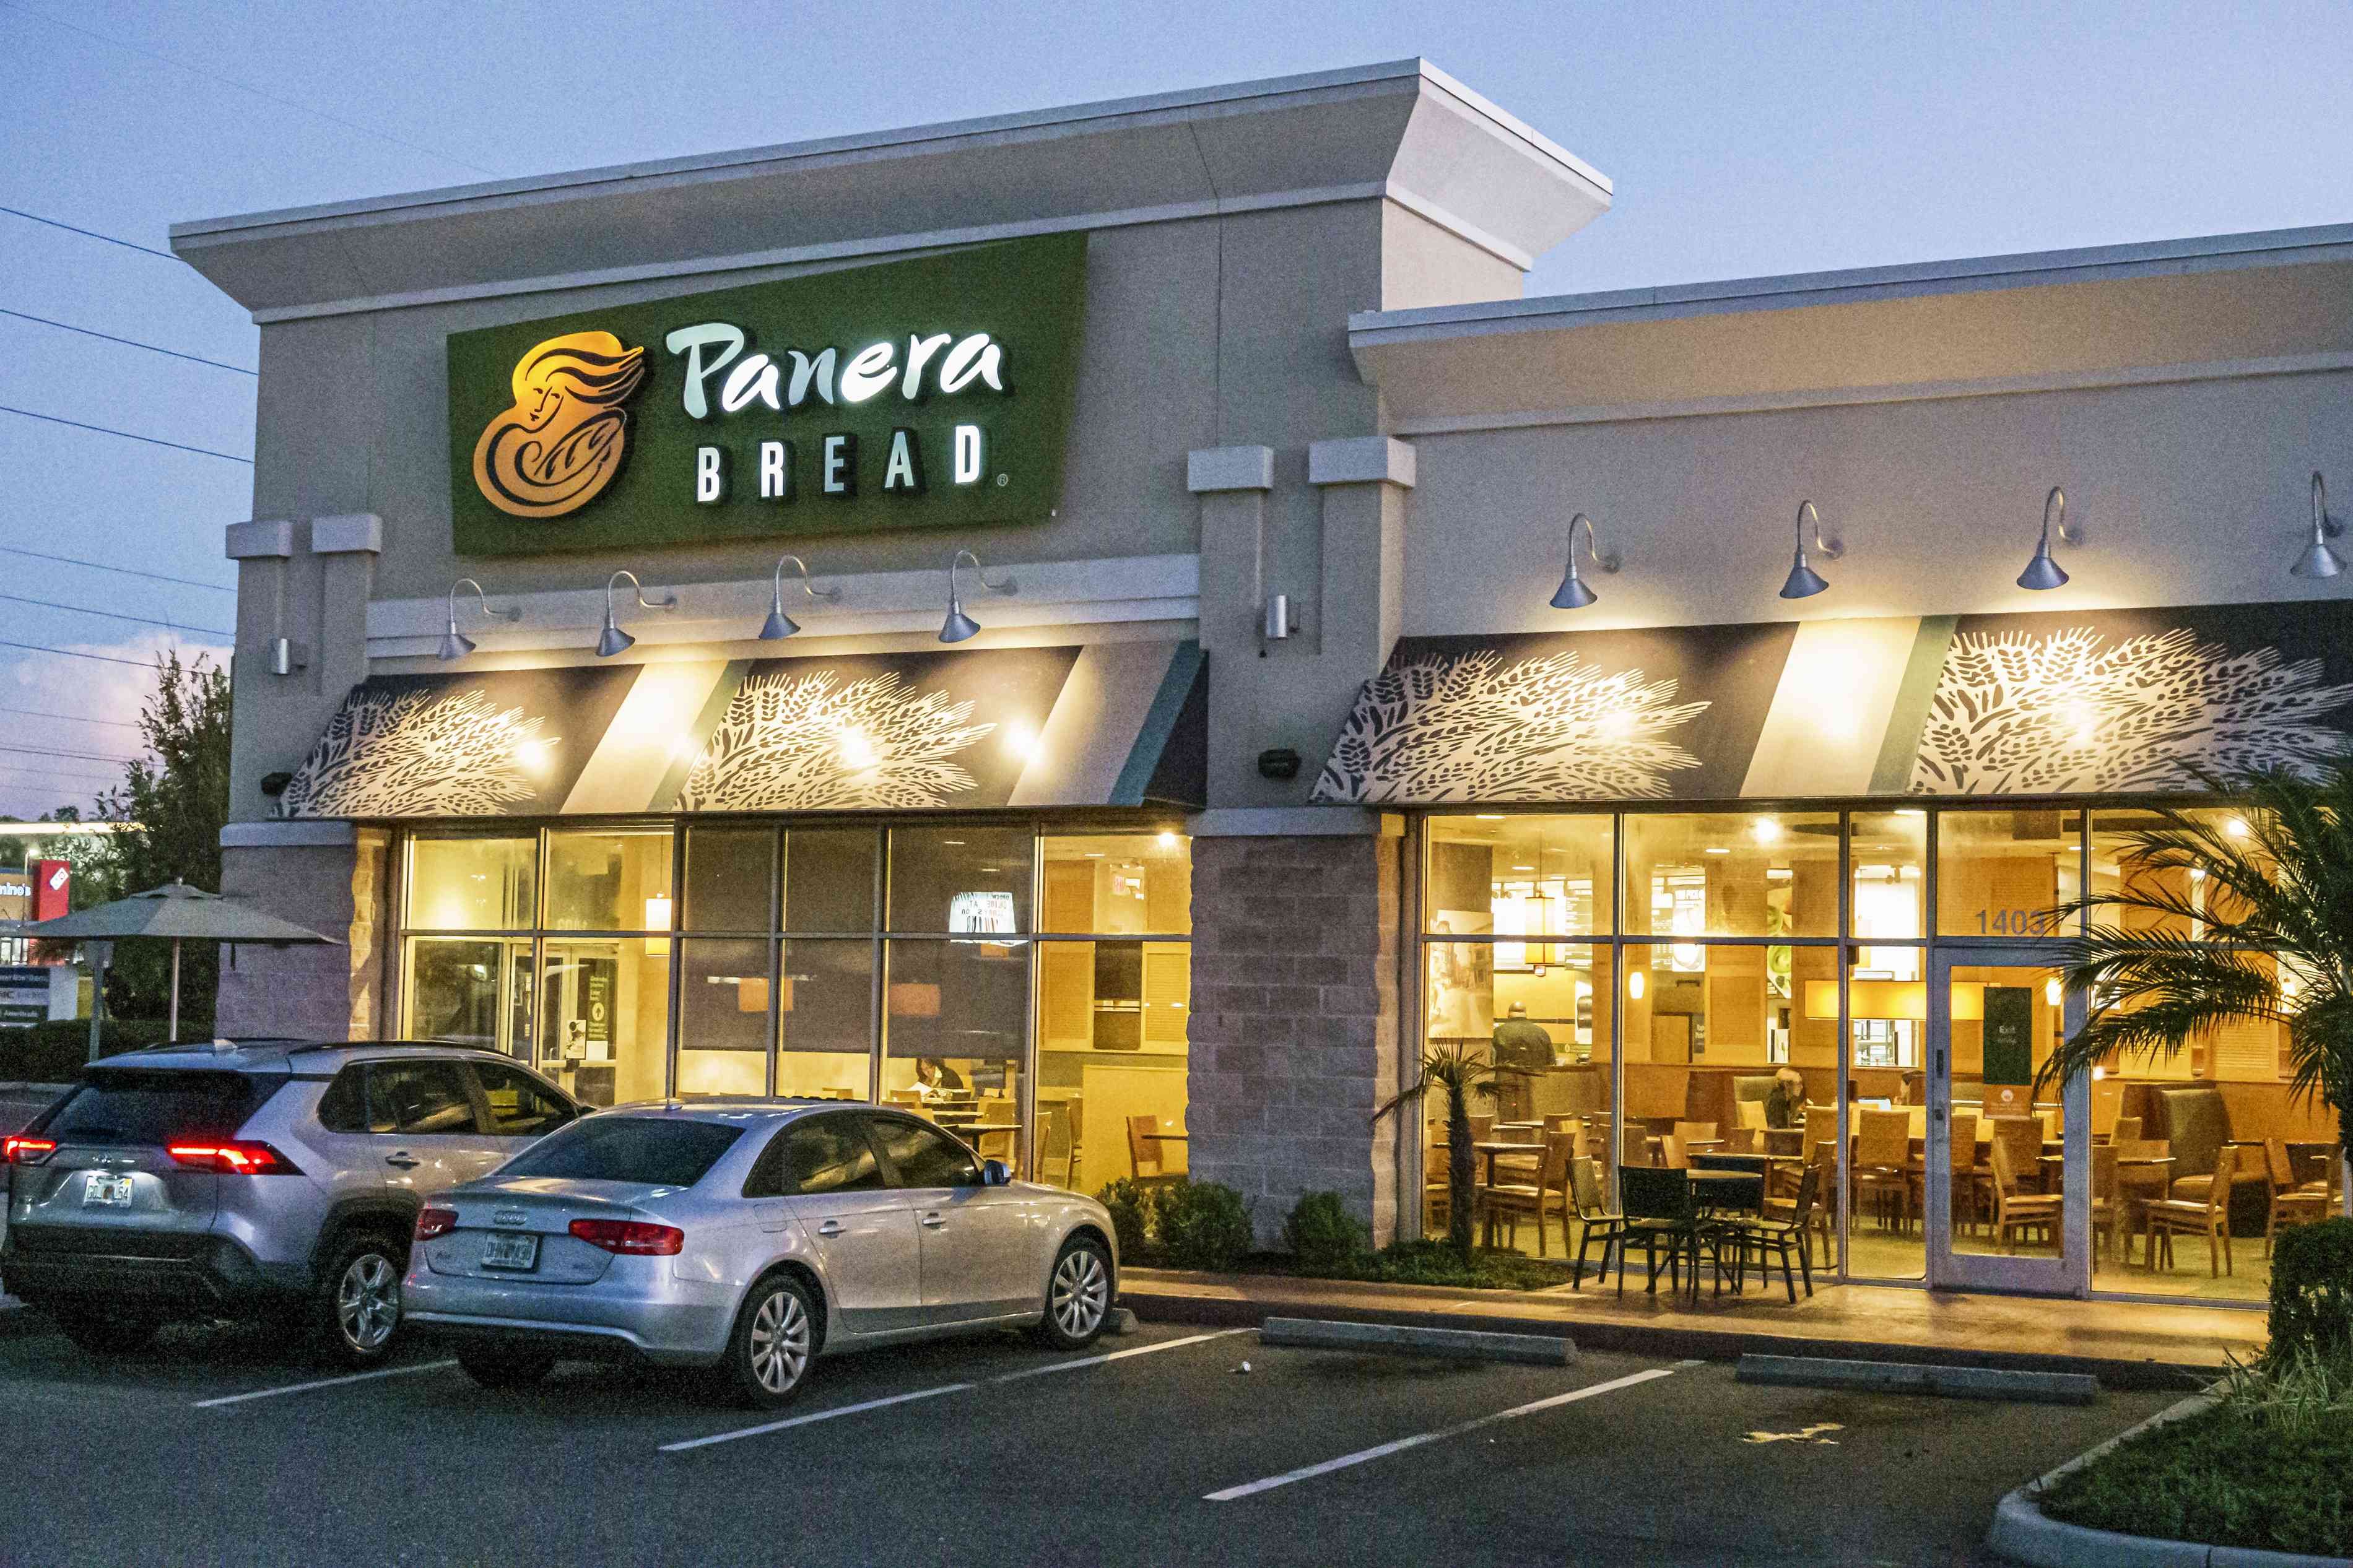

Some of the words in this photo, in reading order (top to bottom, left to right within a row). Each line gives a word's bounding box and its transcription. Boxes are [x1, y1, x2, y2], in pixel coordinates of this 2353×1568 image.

[666, 322, 1003, 419] Panera
[697, 424, 981, 503] BREAD
[1975, 909, 2046, 935] 1403
